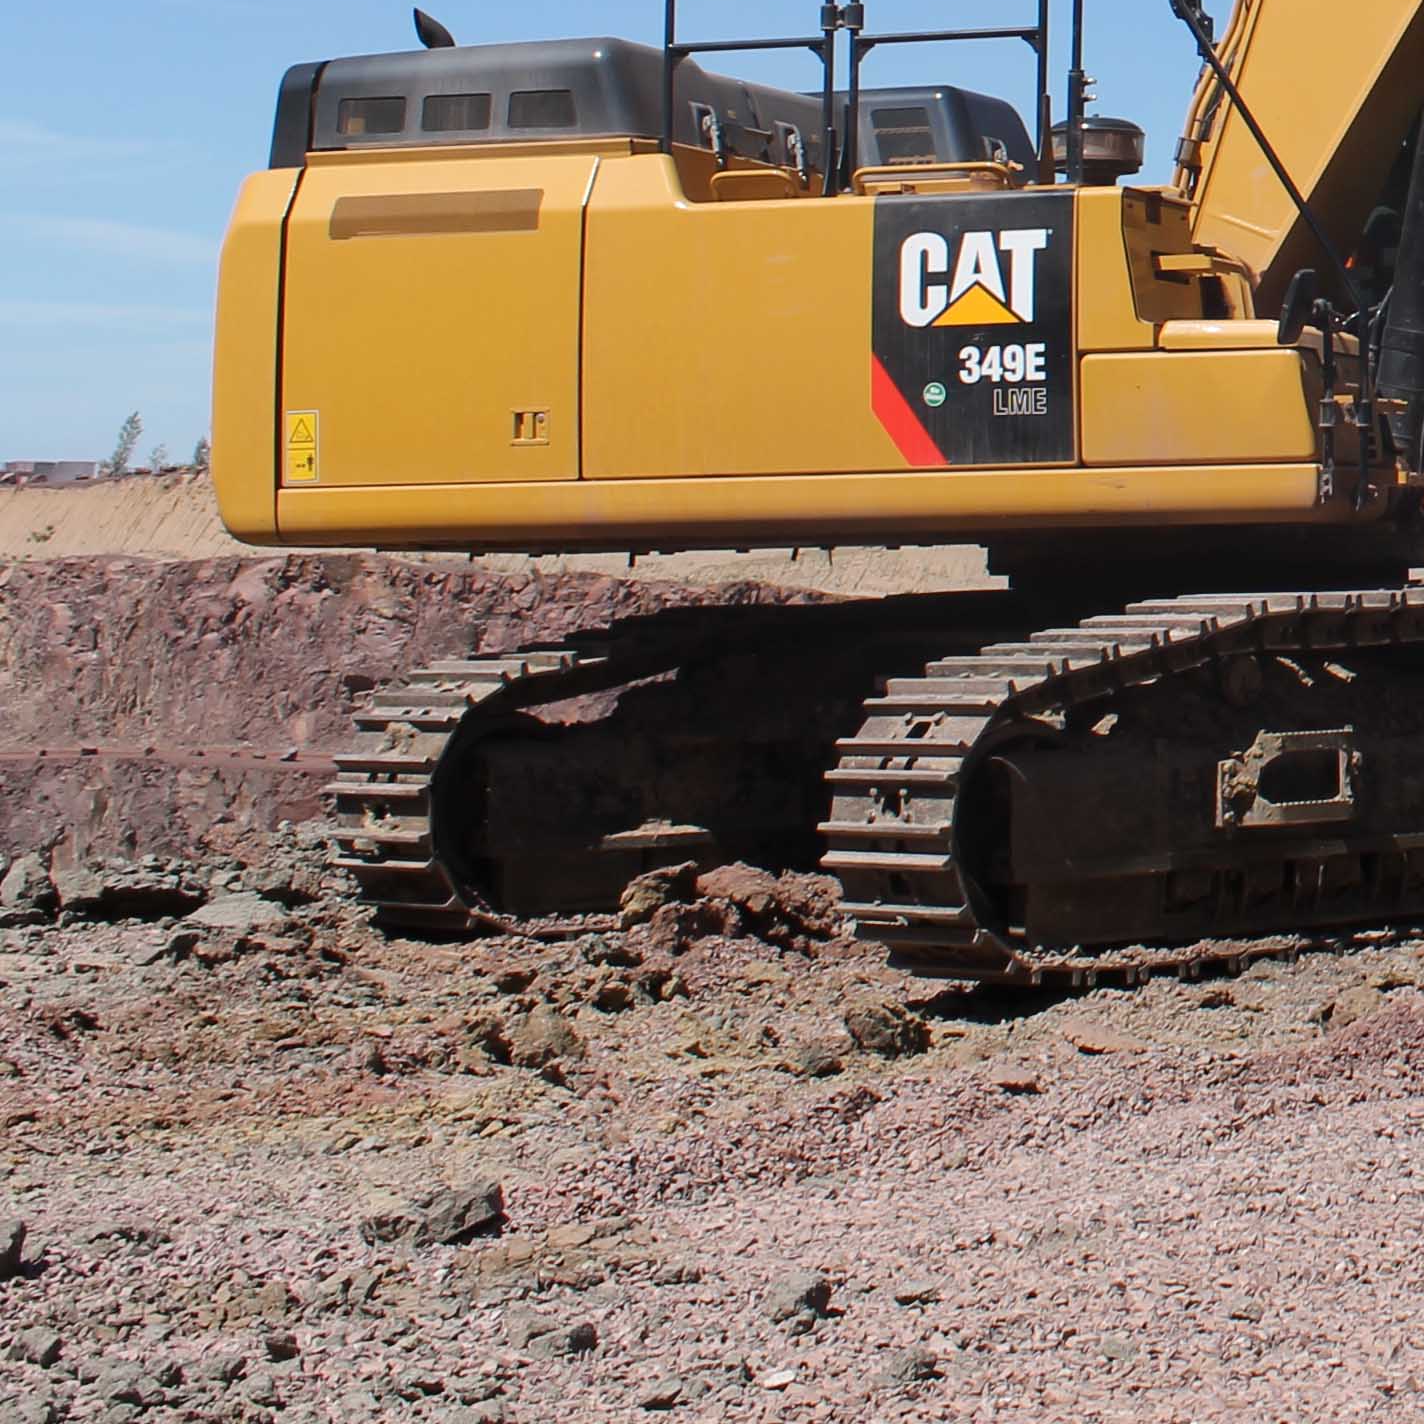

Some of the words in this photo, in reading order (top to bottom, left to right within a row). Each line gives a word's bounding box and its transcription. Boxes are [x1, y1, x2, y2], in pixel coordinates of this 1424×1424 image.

[899, 229, 1048, 327] CAT
[959, 343, 1046, 384] 349E
[993, 388, 1047, 415] LME
